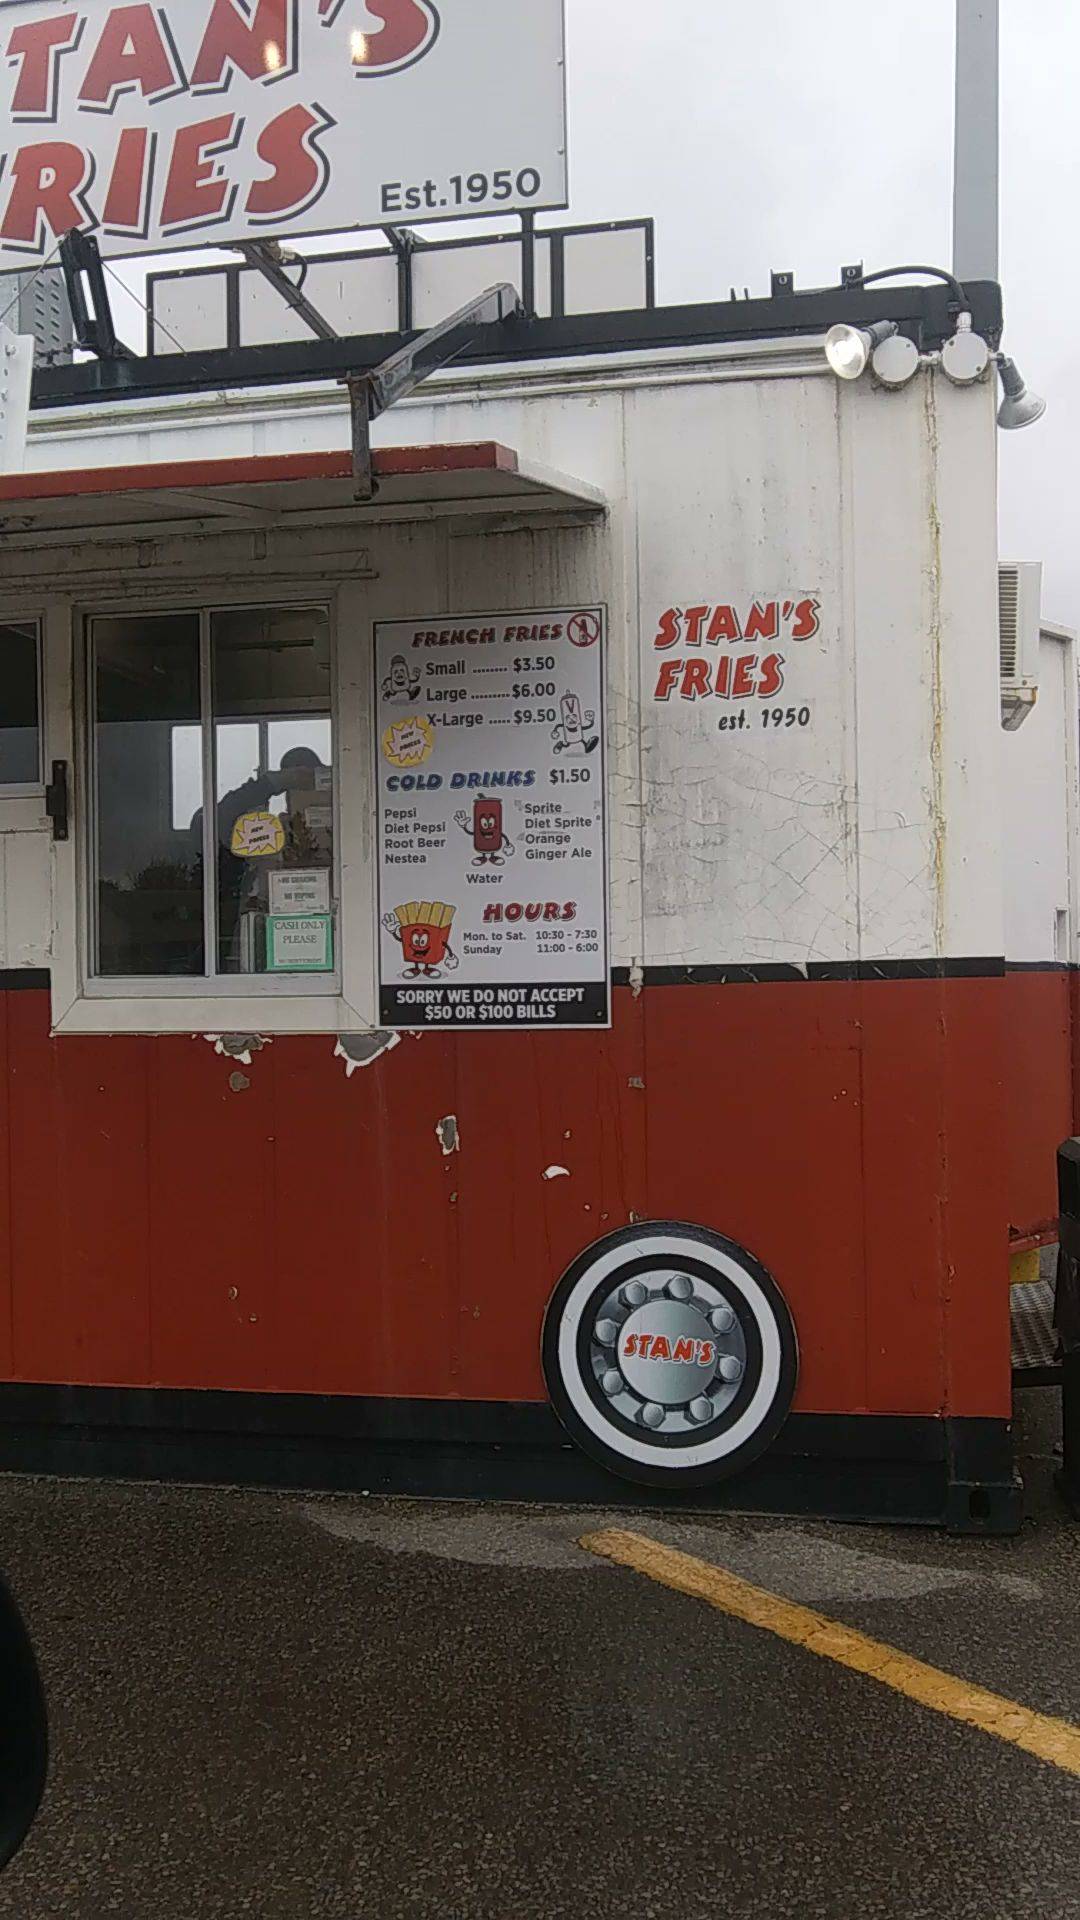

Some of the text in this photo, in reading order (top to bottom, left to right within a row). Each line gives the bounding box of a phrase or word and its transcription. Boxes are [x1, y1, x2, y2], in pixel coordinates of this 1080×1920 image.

[0, 101, 338, 254] RIES
[380, 167, 542, 213] Est.1950
[654, 599, 821, 650] STAN'S
[411, 623, 563, 648] FRENCH FRIES
[426, 656, 555, 675] Small $3.50
[654, 653, 786, 701] FRIES
[426, 682, 556, 702] Large $6.00
[427, 709, 556, 727] X-Large $9.50
[718, 707, 810, 730] est. 1950
[386, 768, 590, 792] COLD DRINKS $1.50
[384, 808, 417, 820] Pepsi
[524, 802, 562, 815] Sprite
[385, 821, 446, 834] Diet Pepsi
[525, 816, 592, 829] Diet Sprite
[385, 837, 446, 848] Root Beer
[525, 834, 571, 845] Orange
[385, 853, 426, 864] Nestea
[525, 847, 592, 860] Ginger Ale
[466, 873, 503, 884] Water
[482, 901, 577, 923] HOURS
[274, 921, 325, 930] CASH ONLY
[282, 935, 318, 944] PLEASE
[463, 932, 489, 941] Mon.
[492, 932, 502, 941] to
[506, 932, 527, 941] Sat.
[536, 931, 564, 940] 10:30
[575, 930, 598, 939] 7:30
[463, 945, 502, 955] Sunday
[536, 944, 566, 953] 11:00
[576, 943, 599, 953] 6:00
[396, 988, 585, 1004] SORRY WE DO NOT ACCEPT
[425, 1004, 556, 1021] $50 OR $100 BILLS
[623, 1333, 717, 1365] STAN'S
